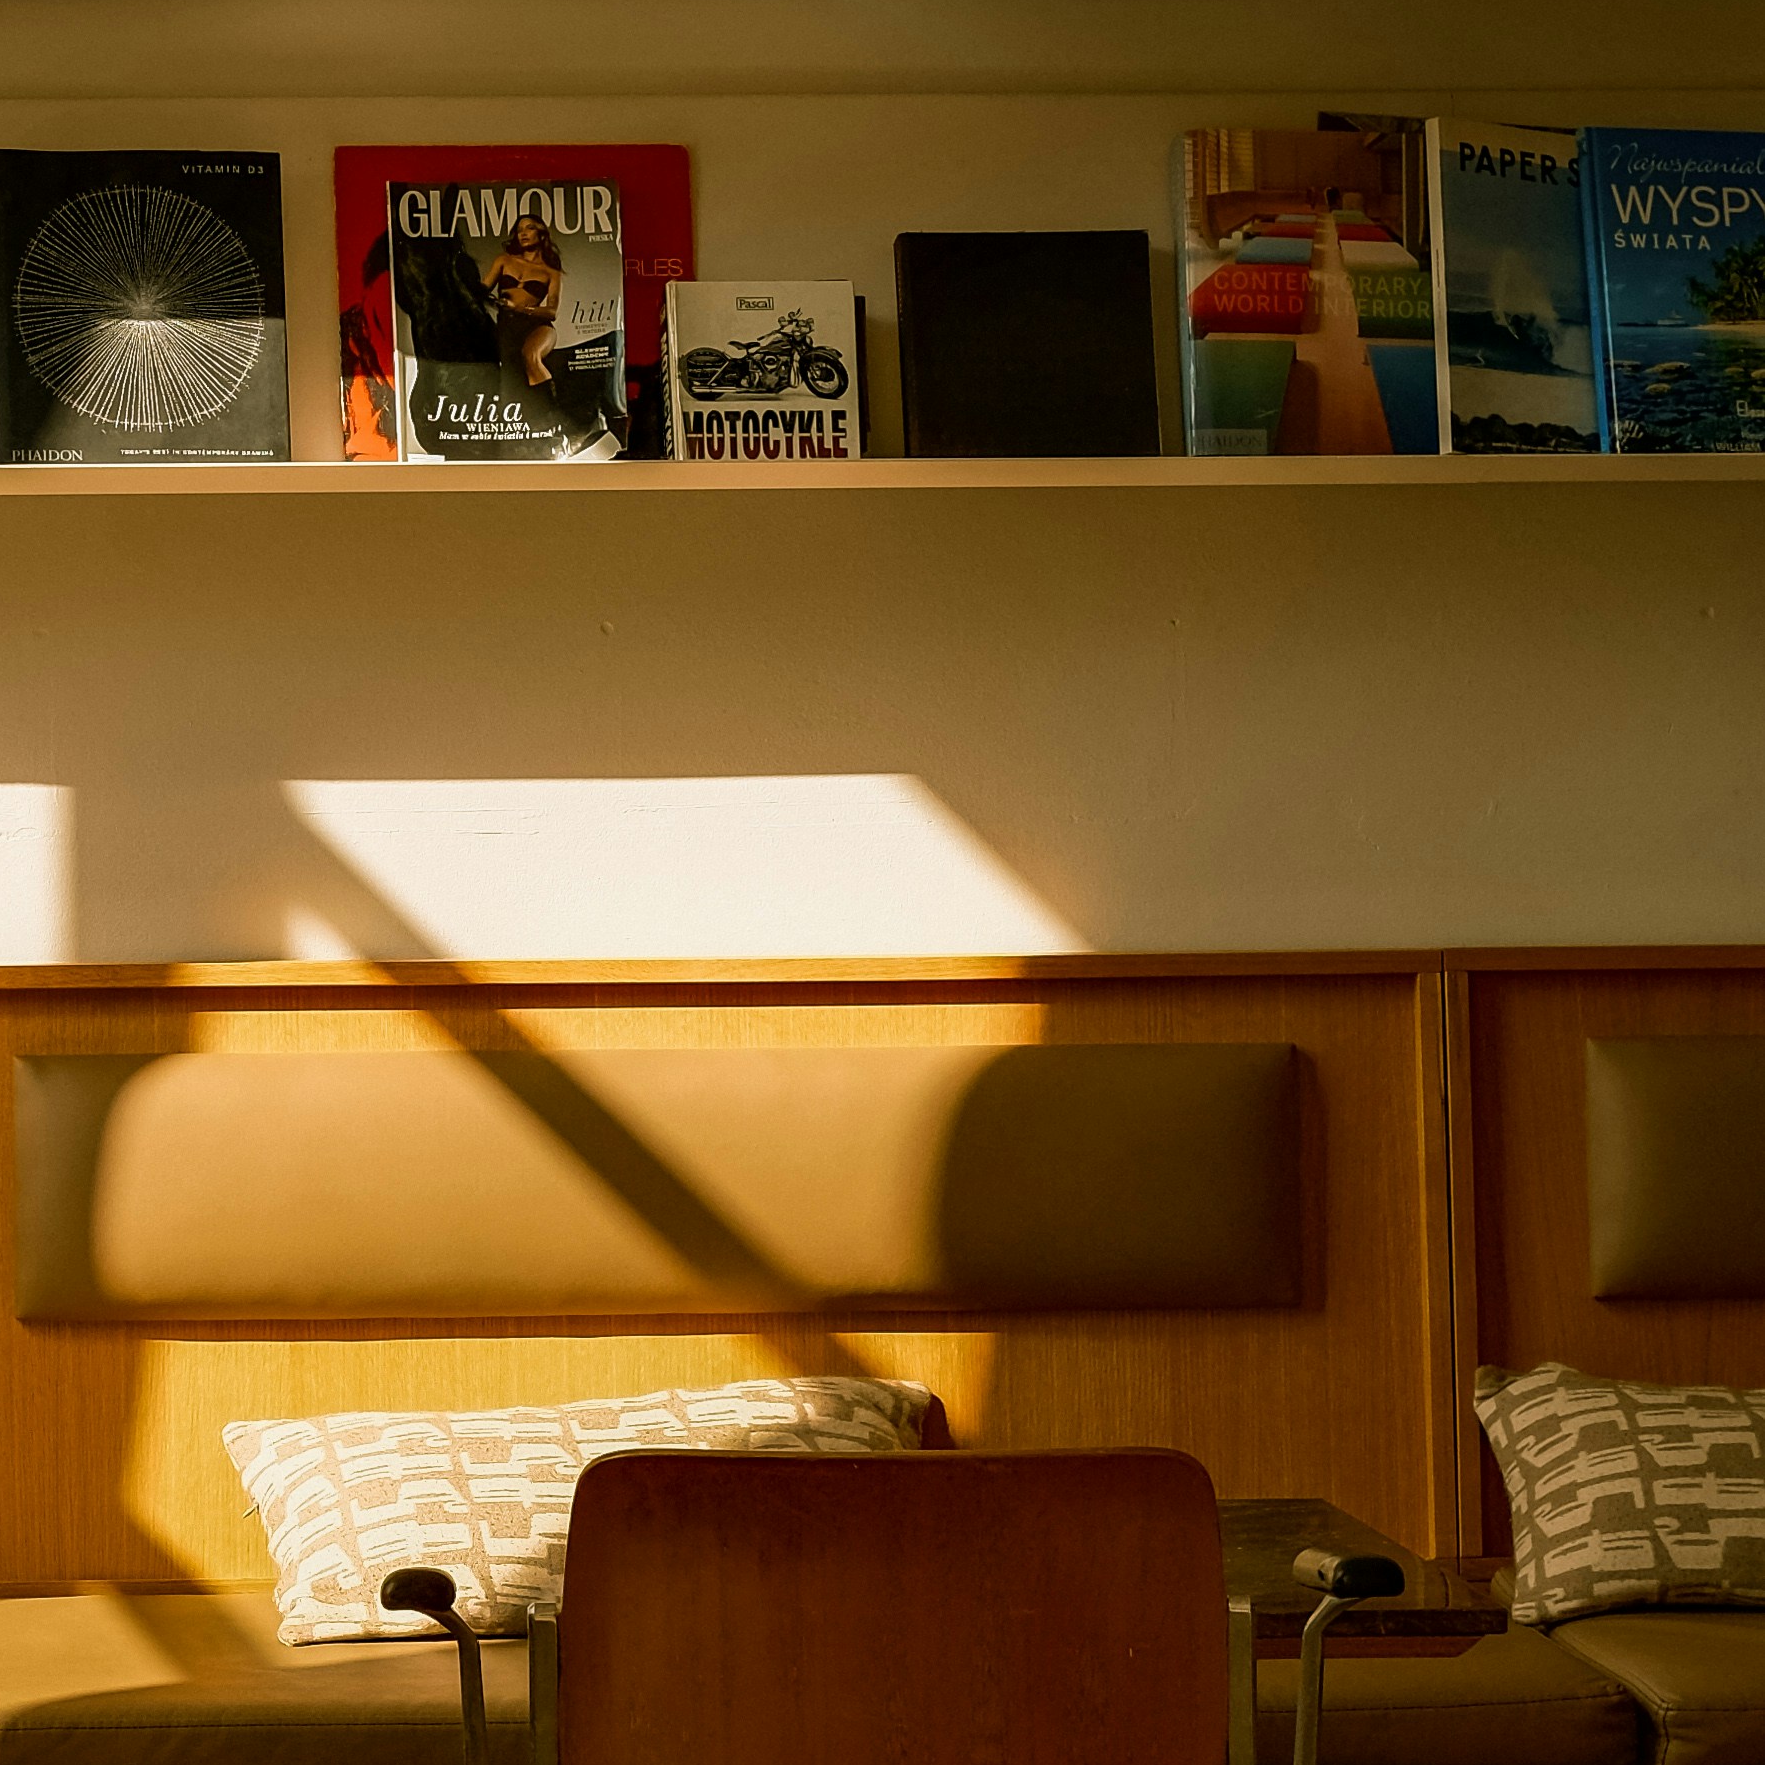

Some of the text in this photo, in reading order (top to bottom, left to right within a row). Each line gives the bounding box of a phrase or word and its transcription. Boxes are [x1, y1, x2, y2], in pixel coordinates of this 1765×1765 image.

[181, 164, 265, 175] VITAMIN D3
[1459, 142, 1558, 186] PAPER
[398, 186, 613, 238] GLAMOUR
[1613, 229, 1711, 251] ŚWIATA
[624, 258, 683, 277] RLES
[739, 298, 772, 309] Pascal
[1213, 293, 1431, 319] WORLD INTERIOR
[427, 393, 523, 423] Julia
[466, 422, 531, 433] WIENIAWA
[684, 409, 848, 460] MOTOCYKLE
[12, 449, 84, 462] PHAIDON
